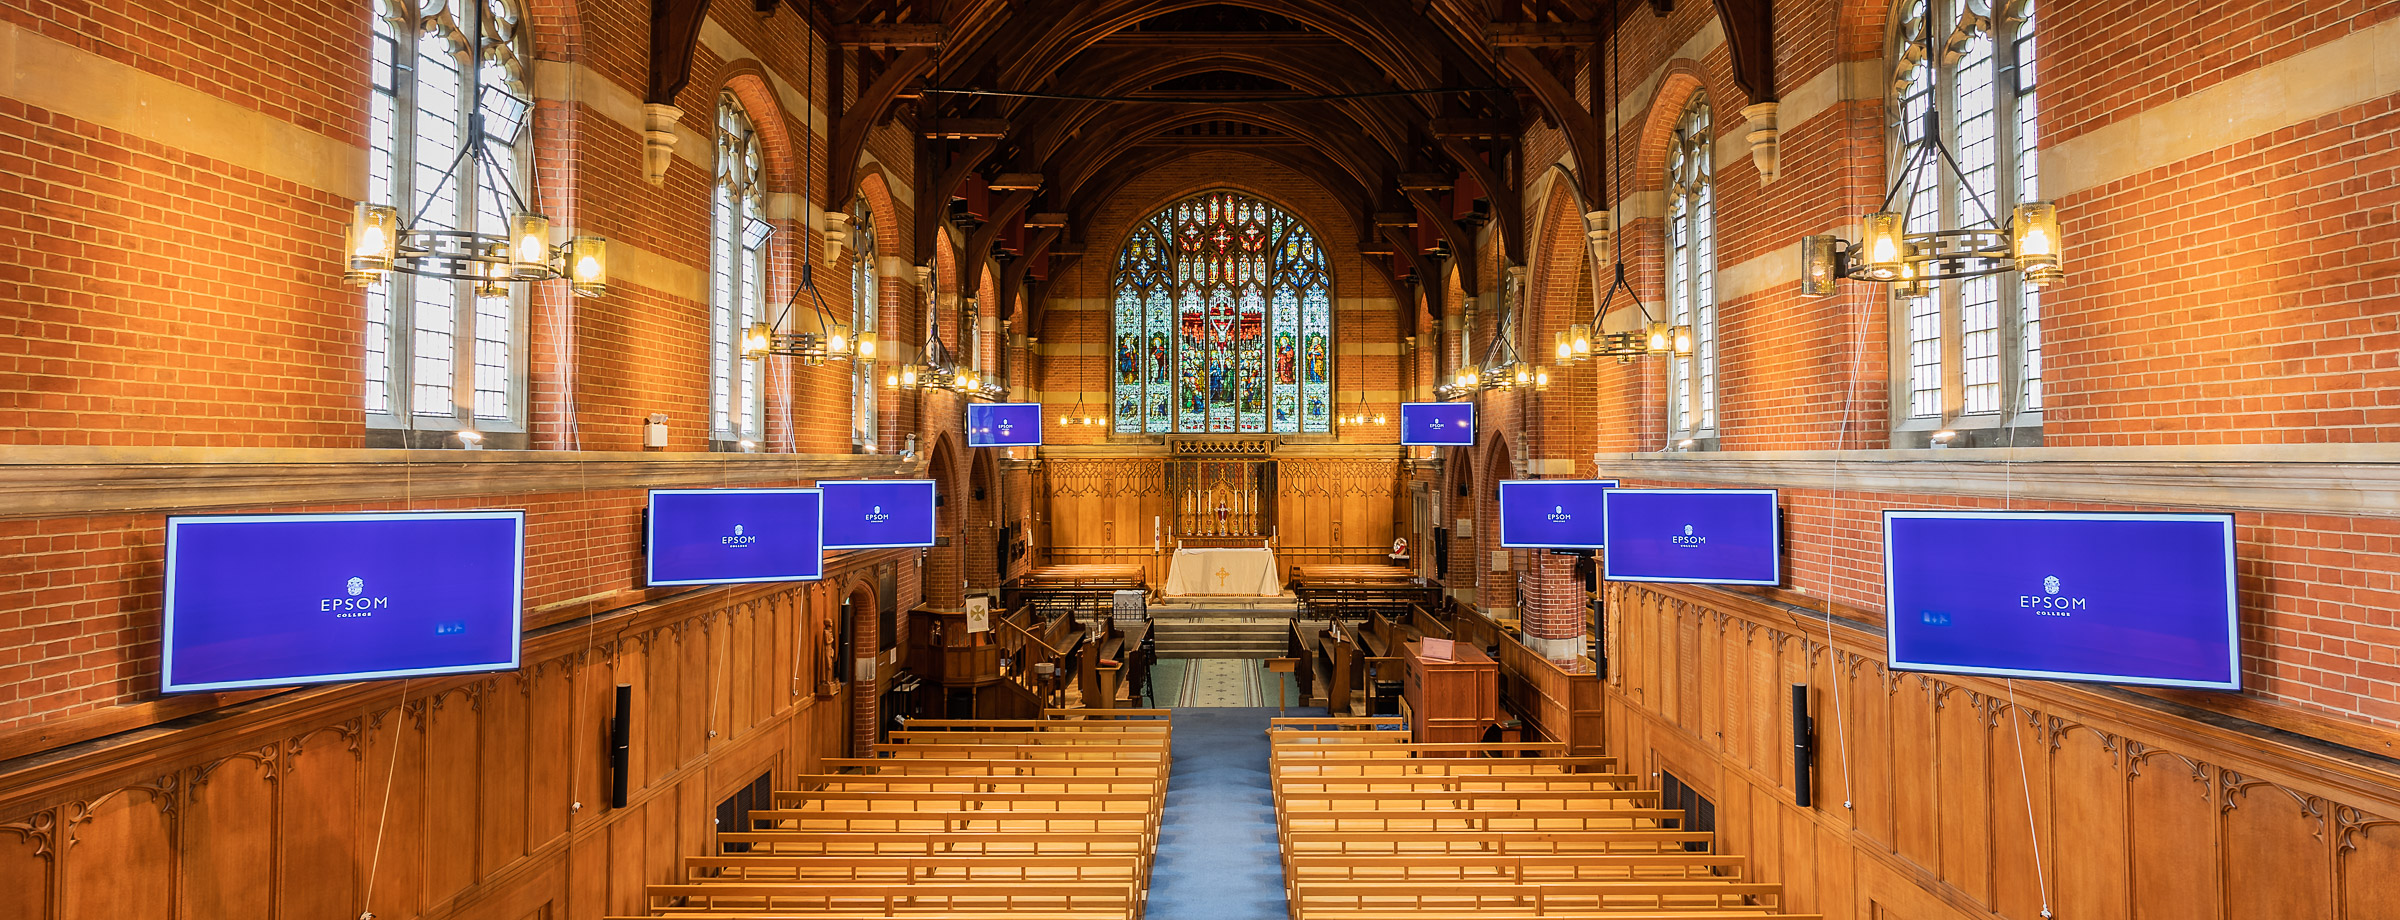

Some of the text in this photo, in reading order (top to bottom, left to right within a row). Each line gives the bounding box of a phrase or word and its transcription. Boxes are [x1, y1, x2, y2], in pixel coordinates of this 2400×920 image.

[722, 536, 756, 544] EPSOM
[1672, 535, 1706, 544] EPSOM
[320, 597, 388, 611] EPSOM
[2020, 595, 2086, 610] EPSOM
